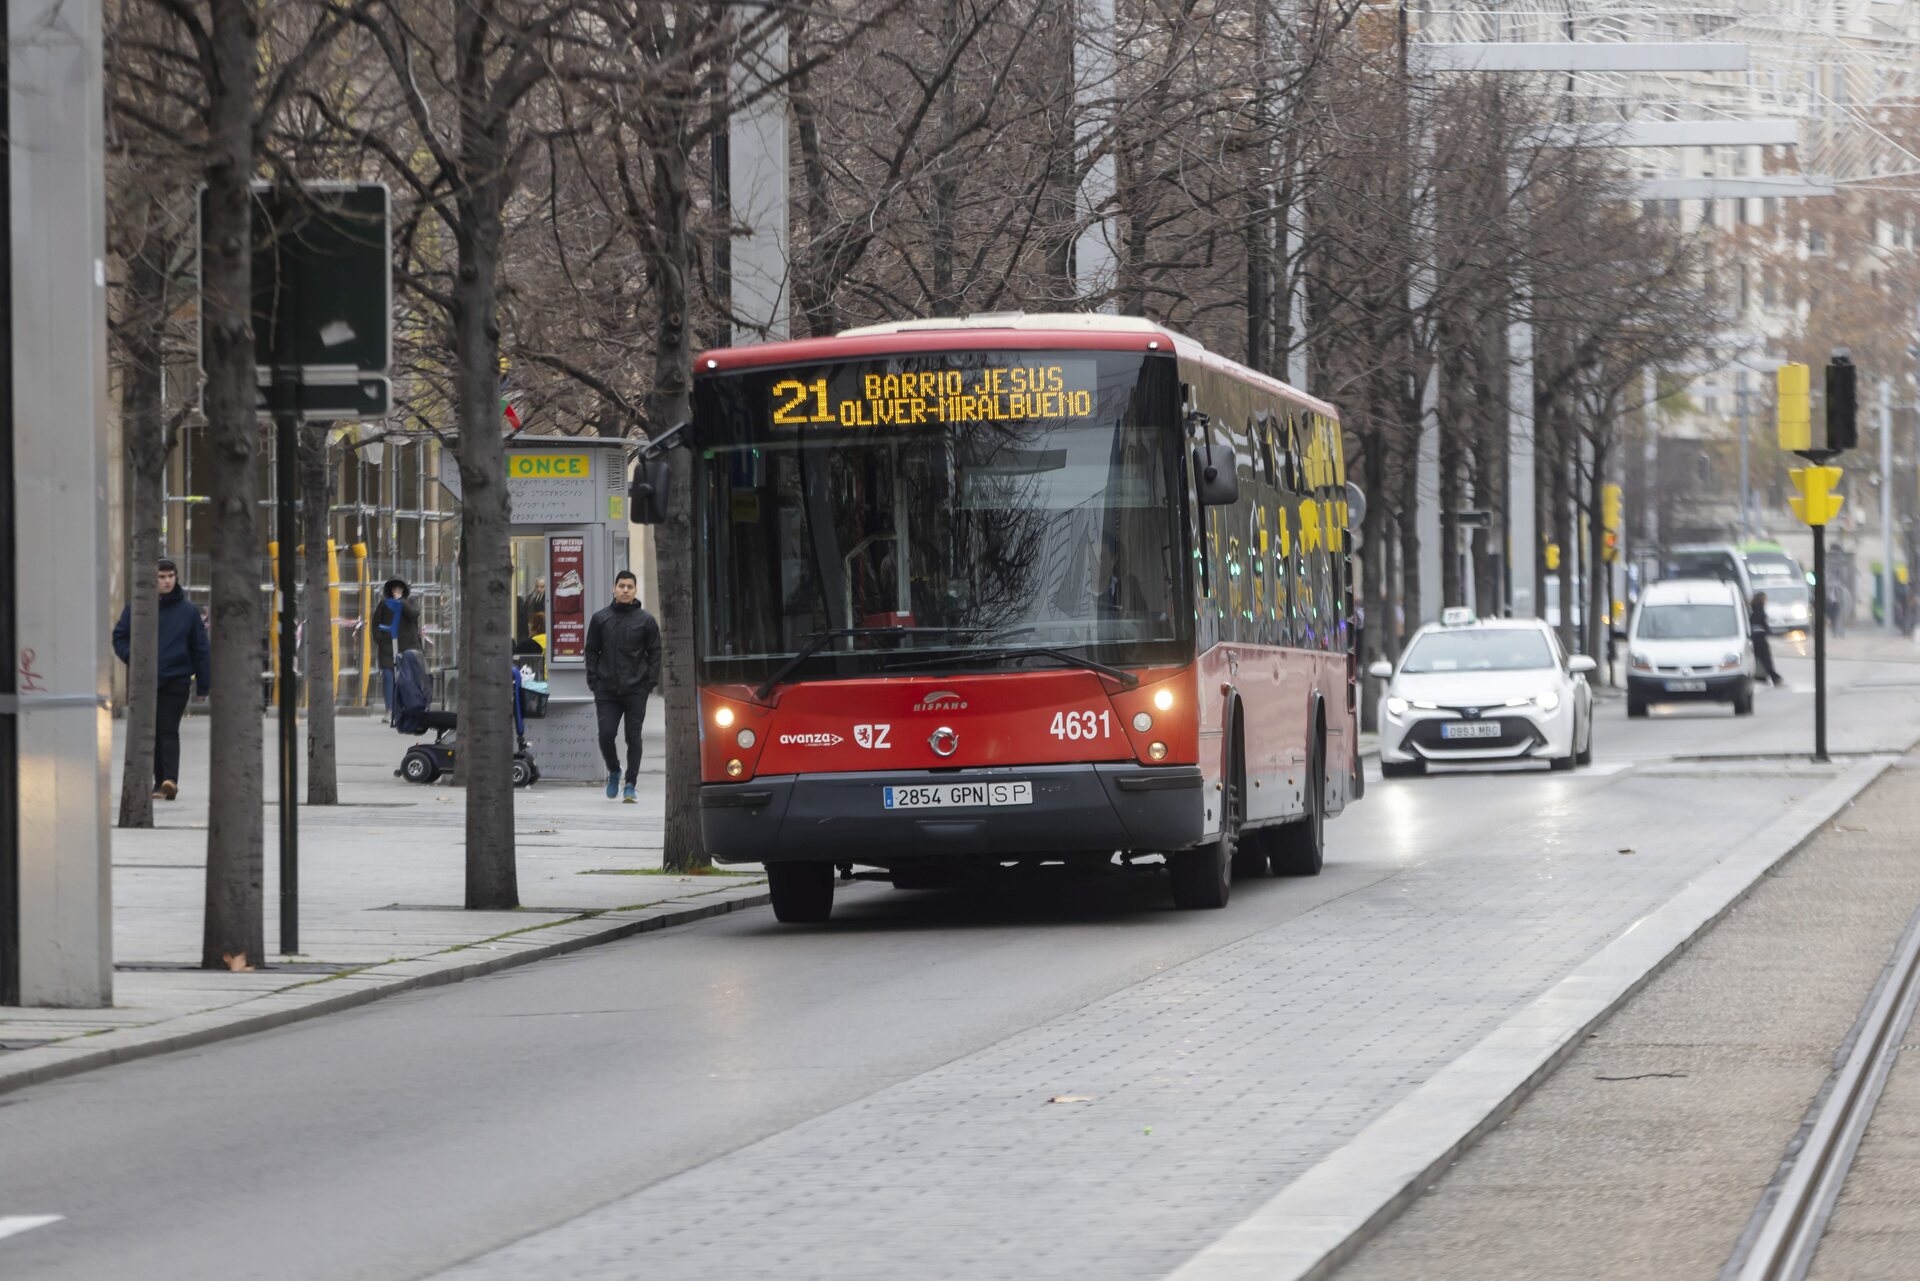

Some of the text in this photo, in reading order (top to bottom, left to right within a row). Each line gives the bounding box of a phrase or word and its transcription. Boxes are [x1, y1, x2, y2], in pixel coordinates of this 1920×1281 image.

[864, 366, 1064, 400] BARRIO JESUS
[772, 378, 836, 424] 21
[518, 458, 581, 474] ONCE
[913, 701, 968, 712] HISPANO
[1050, 710, 1110, 740] 4631
[780, 733, 830, 744] avanza
[874, 724, 891, 749] Z
[898, 788, 942, 806] 2854
[951, 786, 984, 804] GPN
